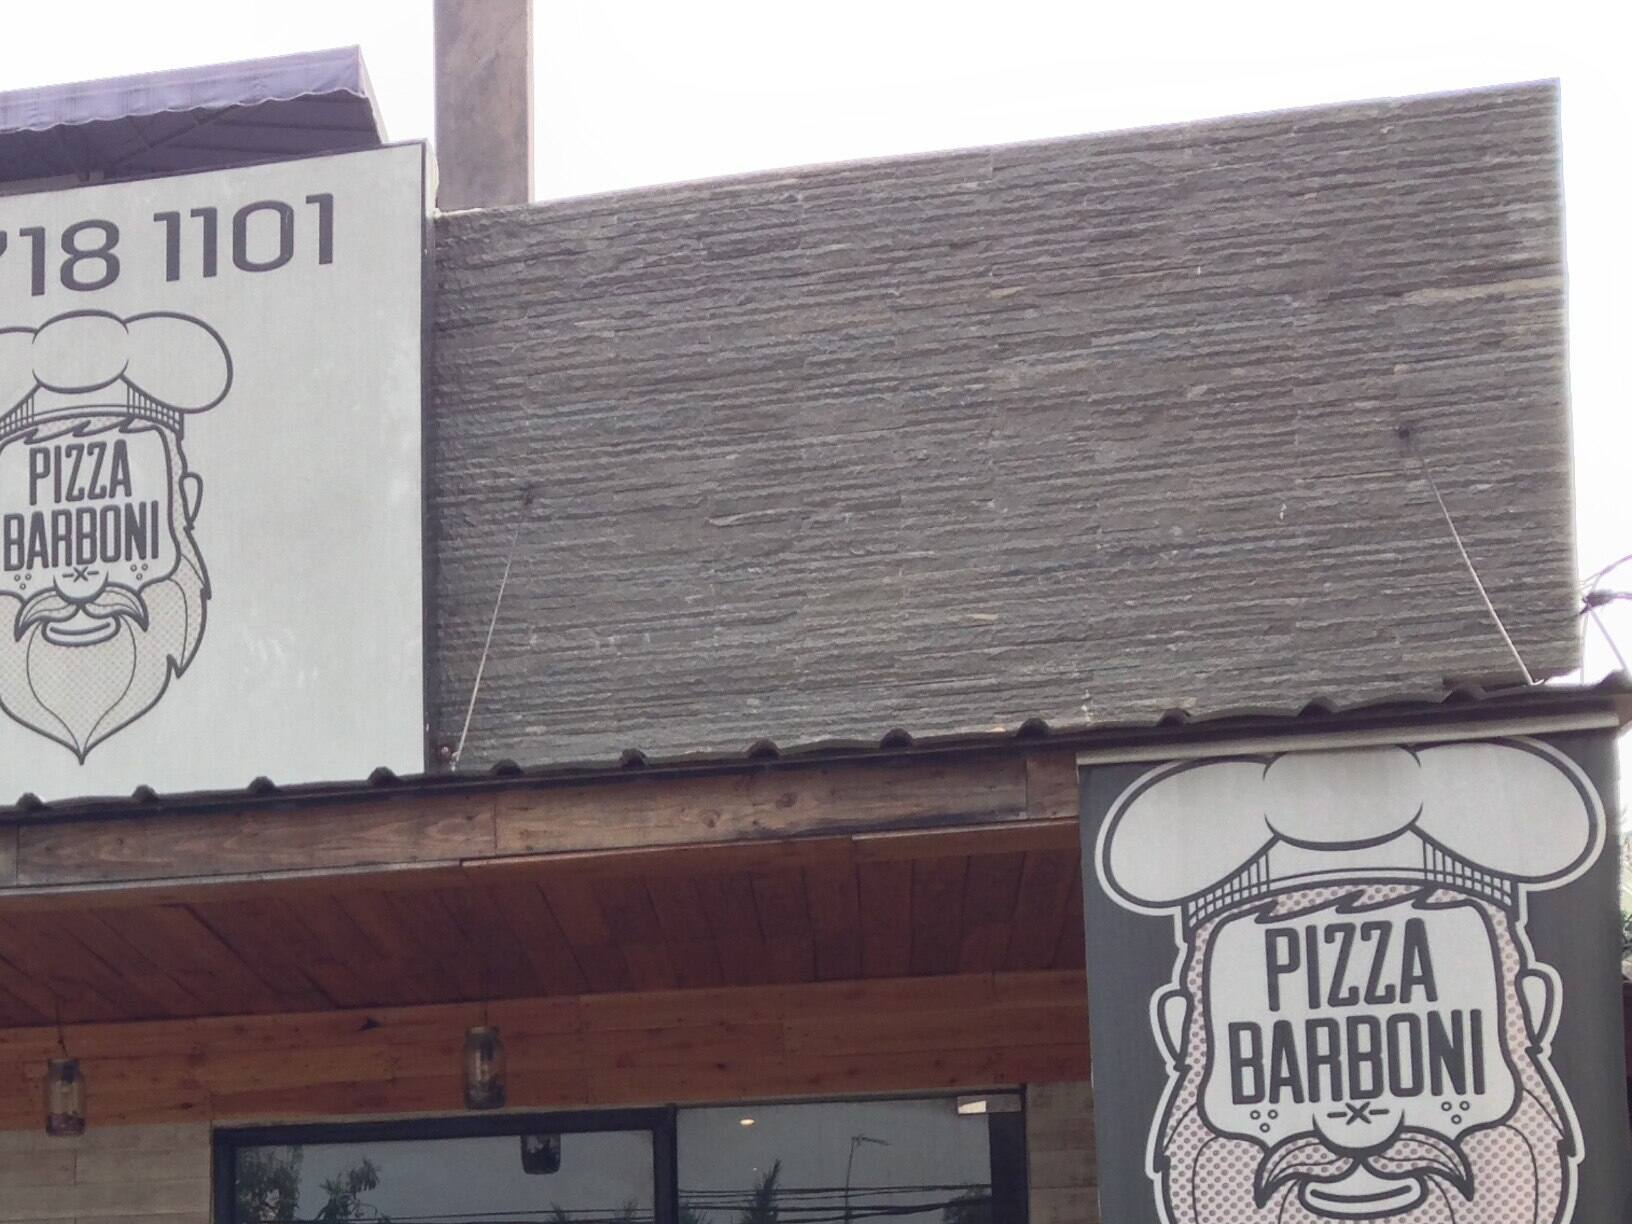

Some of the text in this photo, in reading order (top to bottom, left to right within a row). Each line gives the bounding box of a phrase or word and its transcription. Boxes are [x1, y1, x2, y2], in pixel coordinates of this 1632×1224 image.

[153, 192, 335, 283] 1101
[28, 438, 134, 507] PIZZA
[3, 499, 160, 572] BARBONI
[1264, 917, 1439, 1013] PIZZA
[1227, 1008, 1487, 1106] BARBONI
